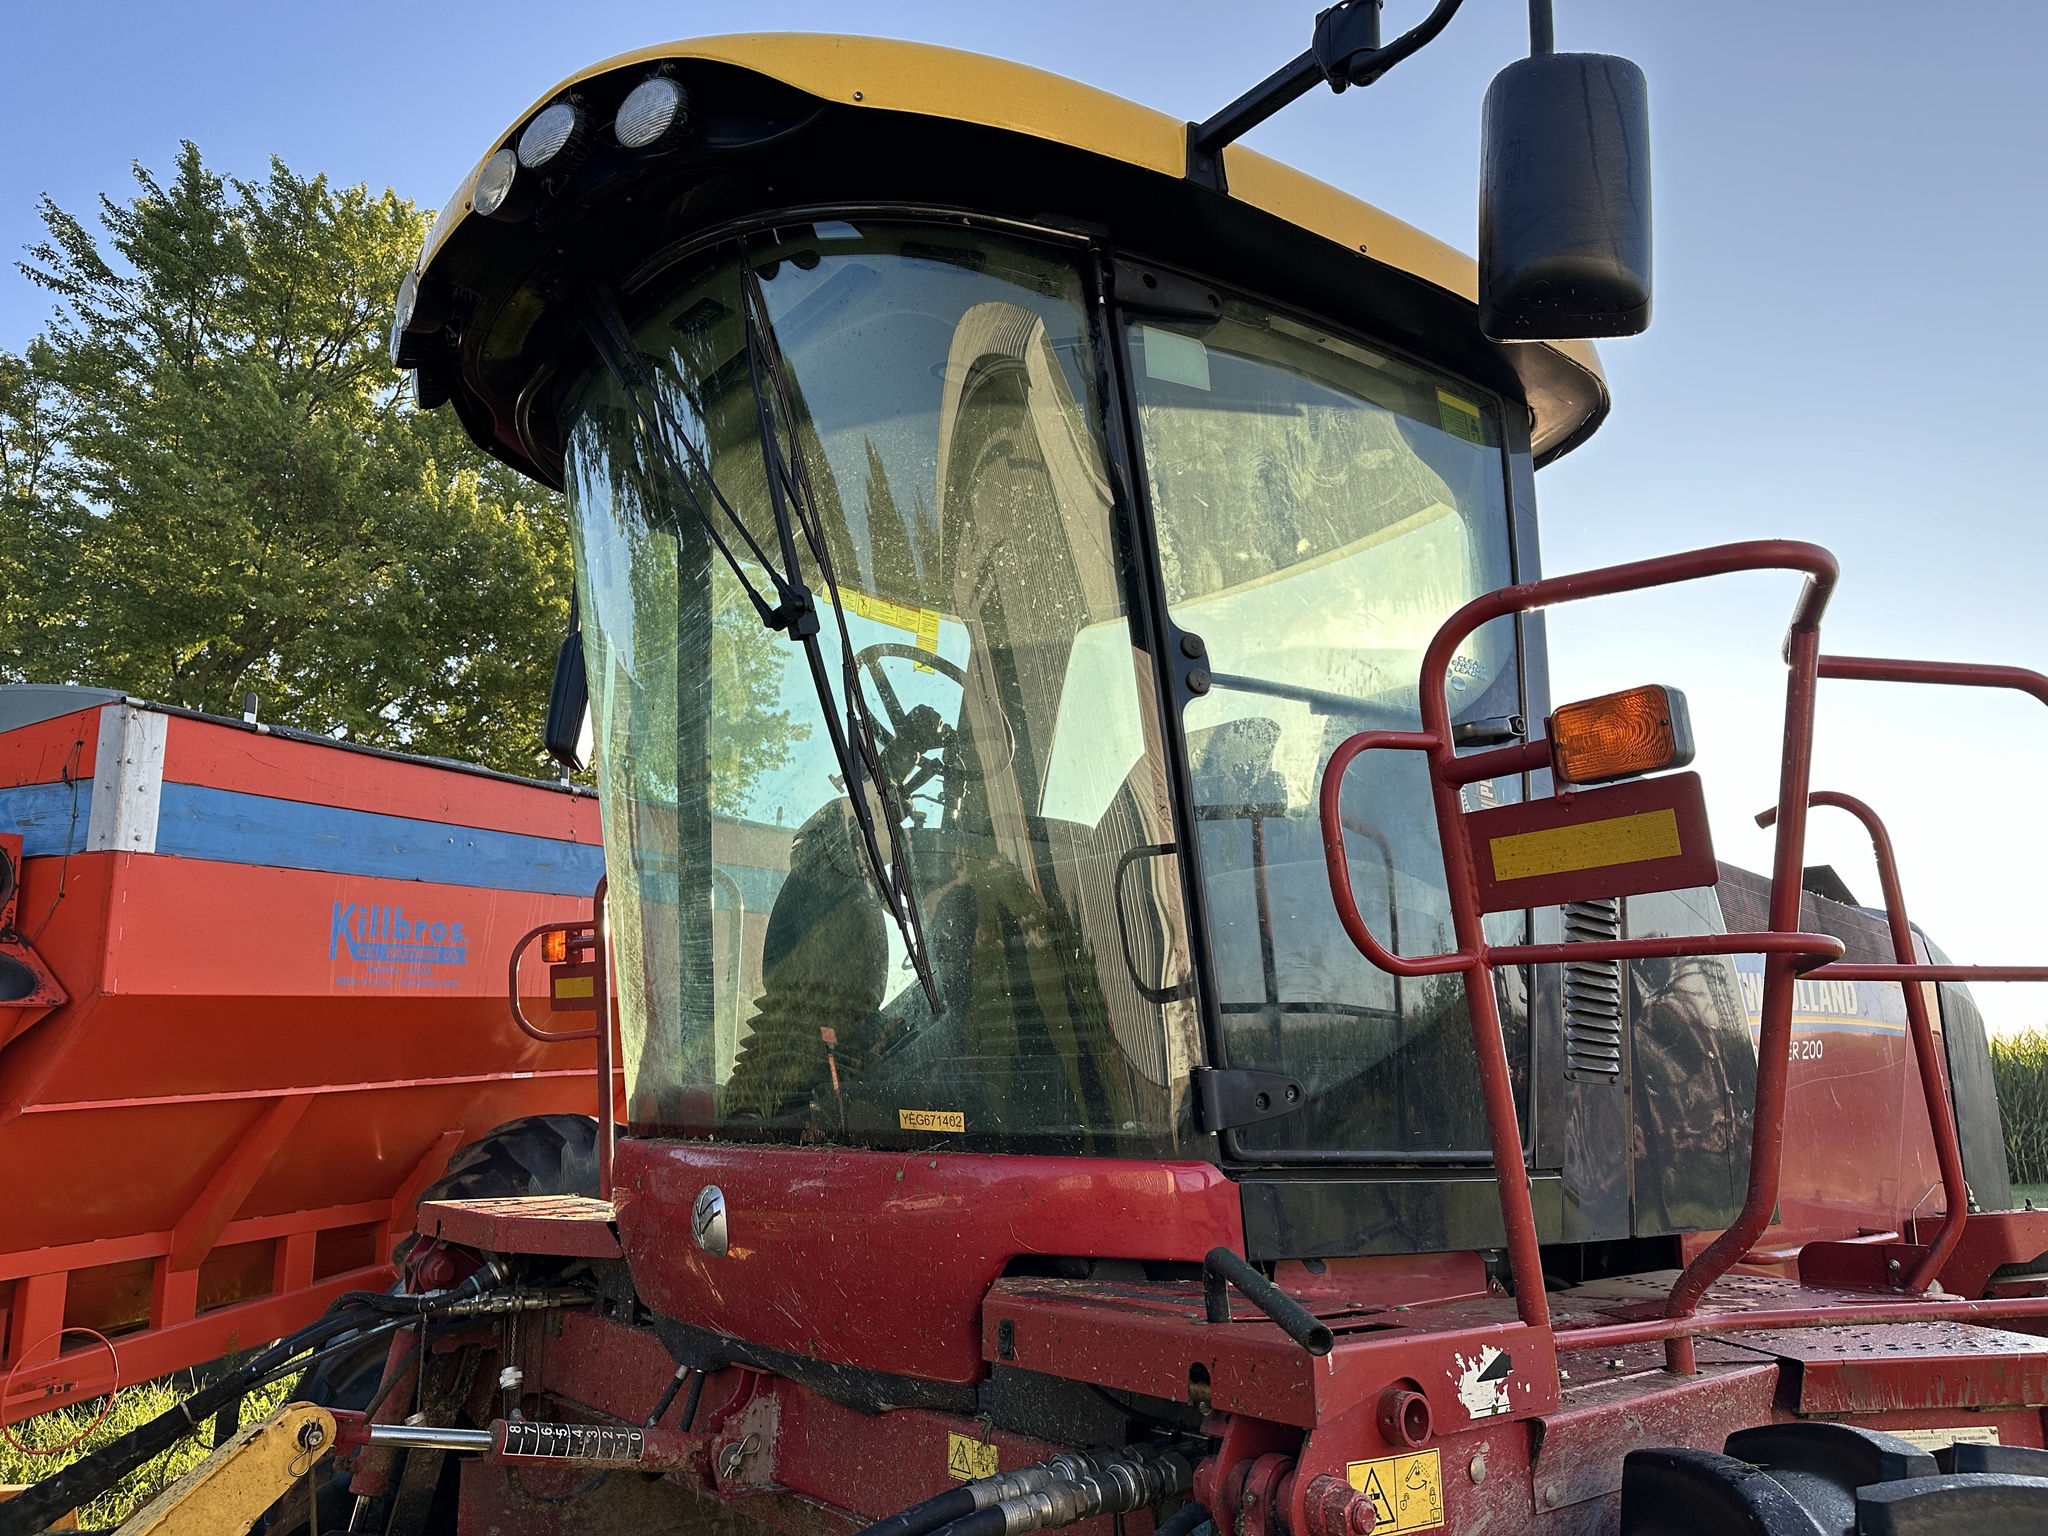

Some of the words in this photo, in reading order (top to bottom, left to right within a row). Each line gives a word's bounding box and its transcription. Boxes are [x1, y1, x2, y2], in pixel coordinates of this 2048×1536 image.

[329, 902, 464, 960] Killbros
[357, 946, 380, 959] KILL
[385, 947, 440, 961] BROTHERS
[367, 965, 401, 976] MODEL
[336, 976, 358, 987] MADE
[361, 977, 370, 987] IN
[439, 979, 459, 988] OHIO
[1793, 980, 1858, 1015] LLAND
[1802, 1040, 1823, 1060] 200
